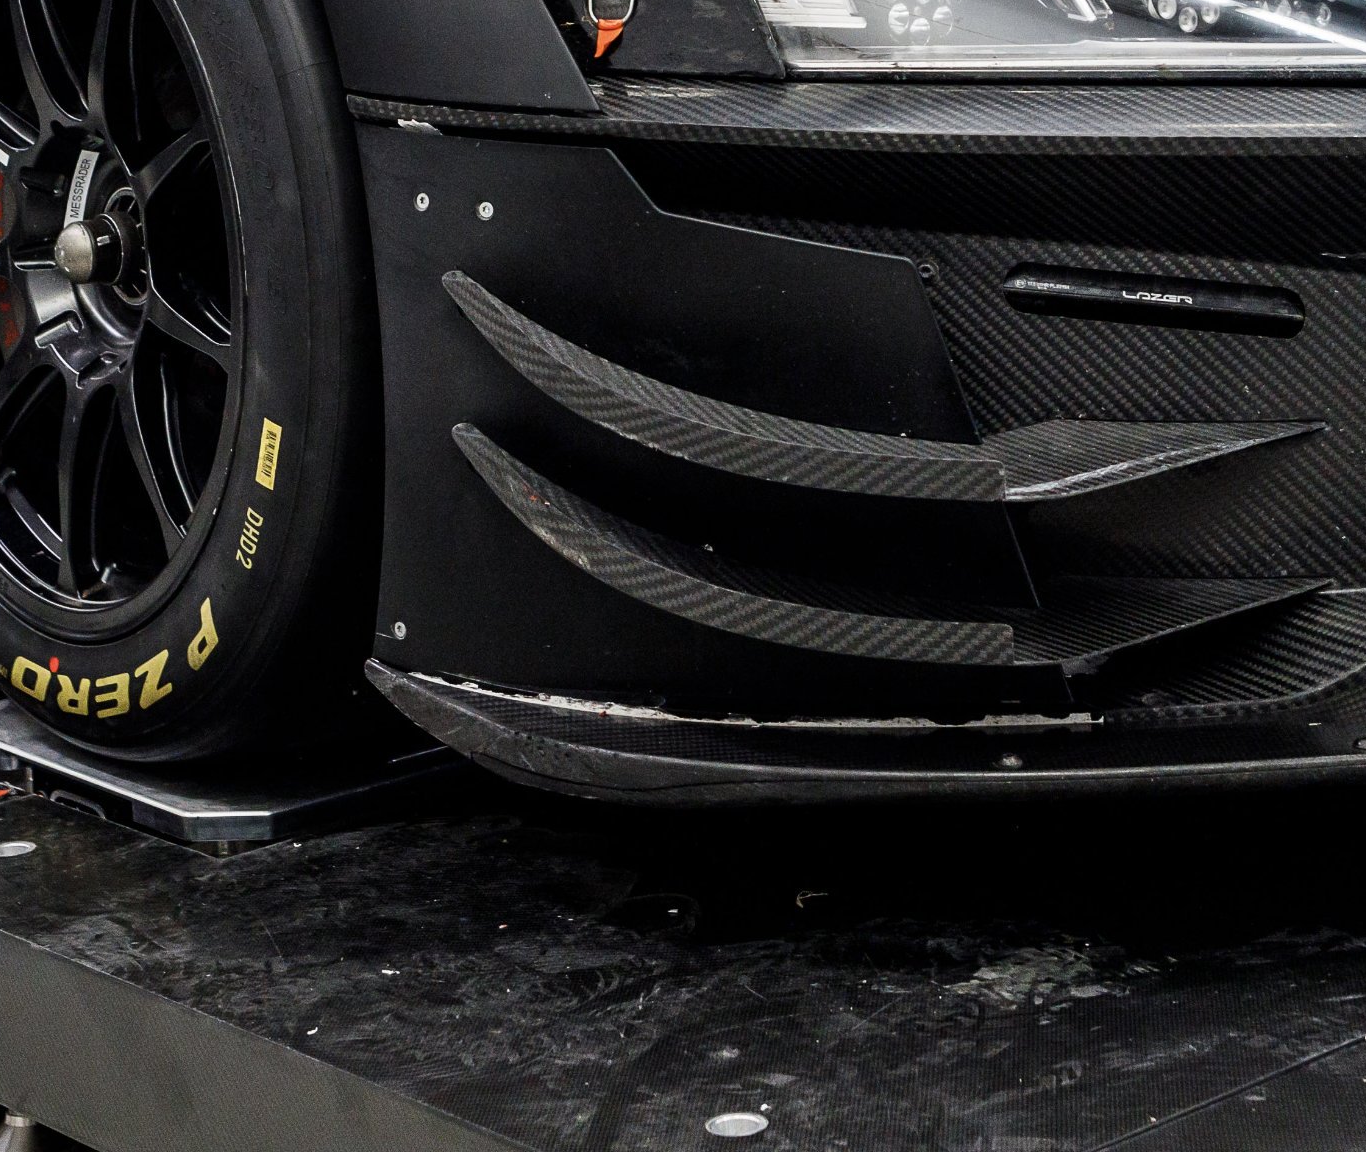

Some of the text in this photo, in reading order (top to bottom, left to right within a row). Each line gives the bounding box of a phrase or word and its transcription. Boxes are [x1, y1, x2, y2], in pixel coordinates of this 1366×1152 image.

[1122, 290, 1193, 304] LAZER
[235, 506, 265, 570] DHD2
[11, 597, 220, 719] P ZERO
